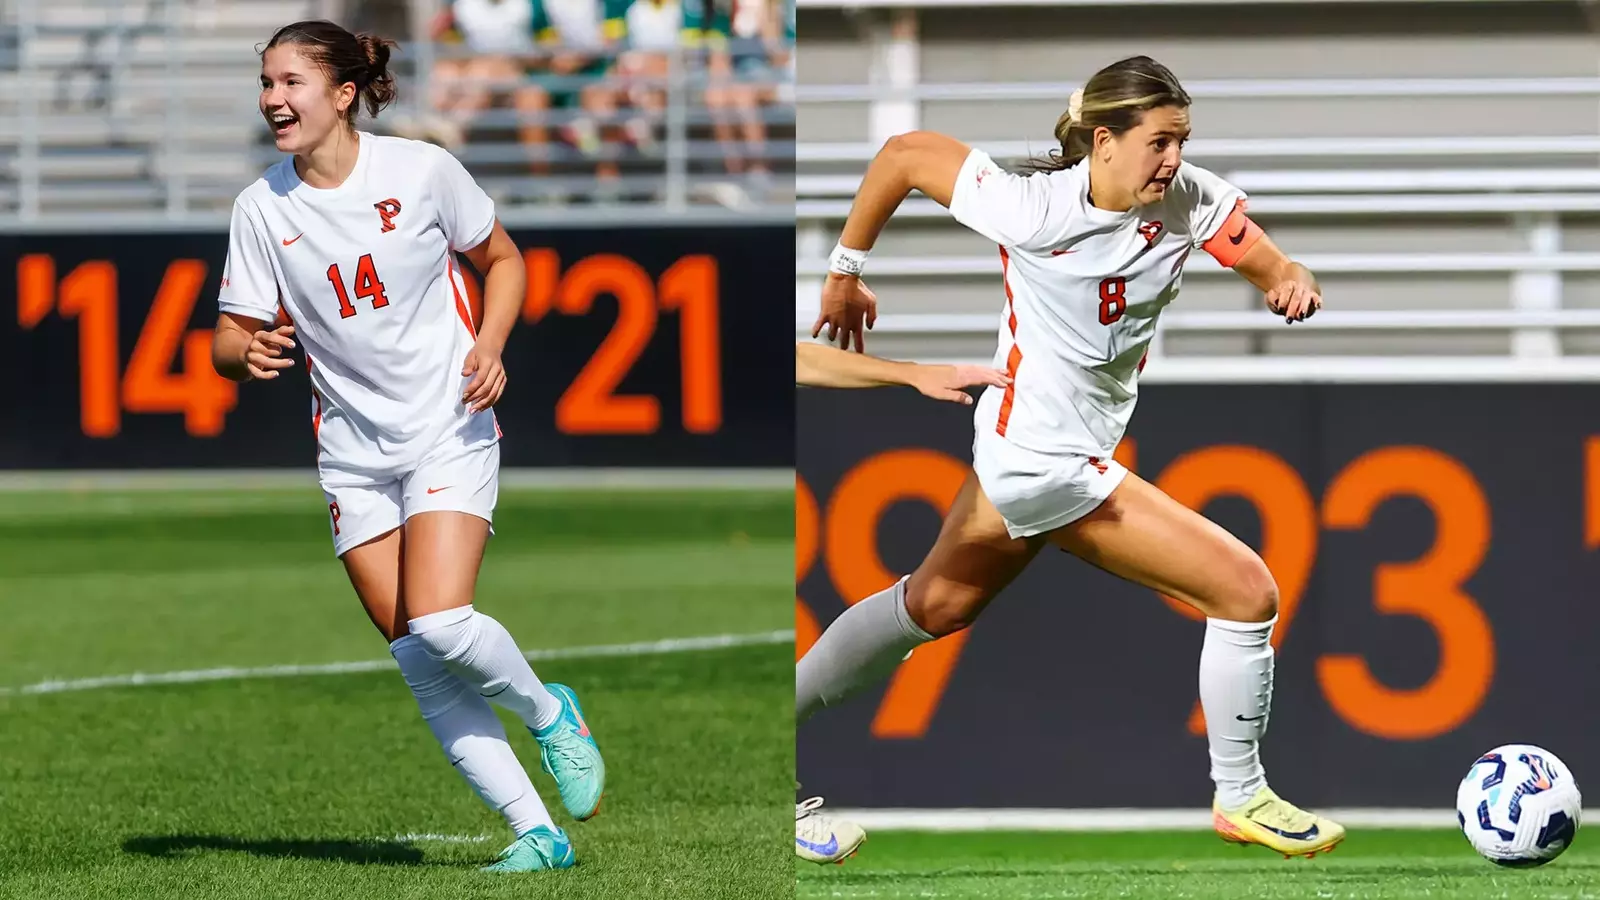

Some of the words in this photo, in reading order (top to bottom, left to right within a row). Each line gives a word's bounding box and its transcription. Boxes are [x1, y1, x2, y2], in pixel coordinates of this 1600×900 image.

[373, 197, 402, 234] P
[326, 252, 390, 320] 14
[1098, 276, 1127, 326] 8
[17, 253, 238, 438] '14
[523, 246, 722, 436] '21
